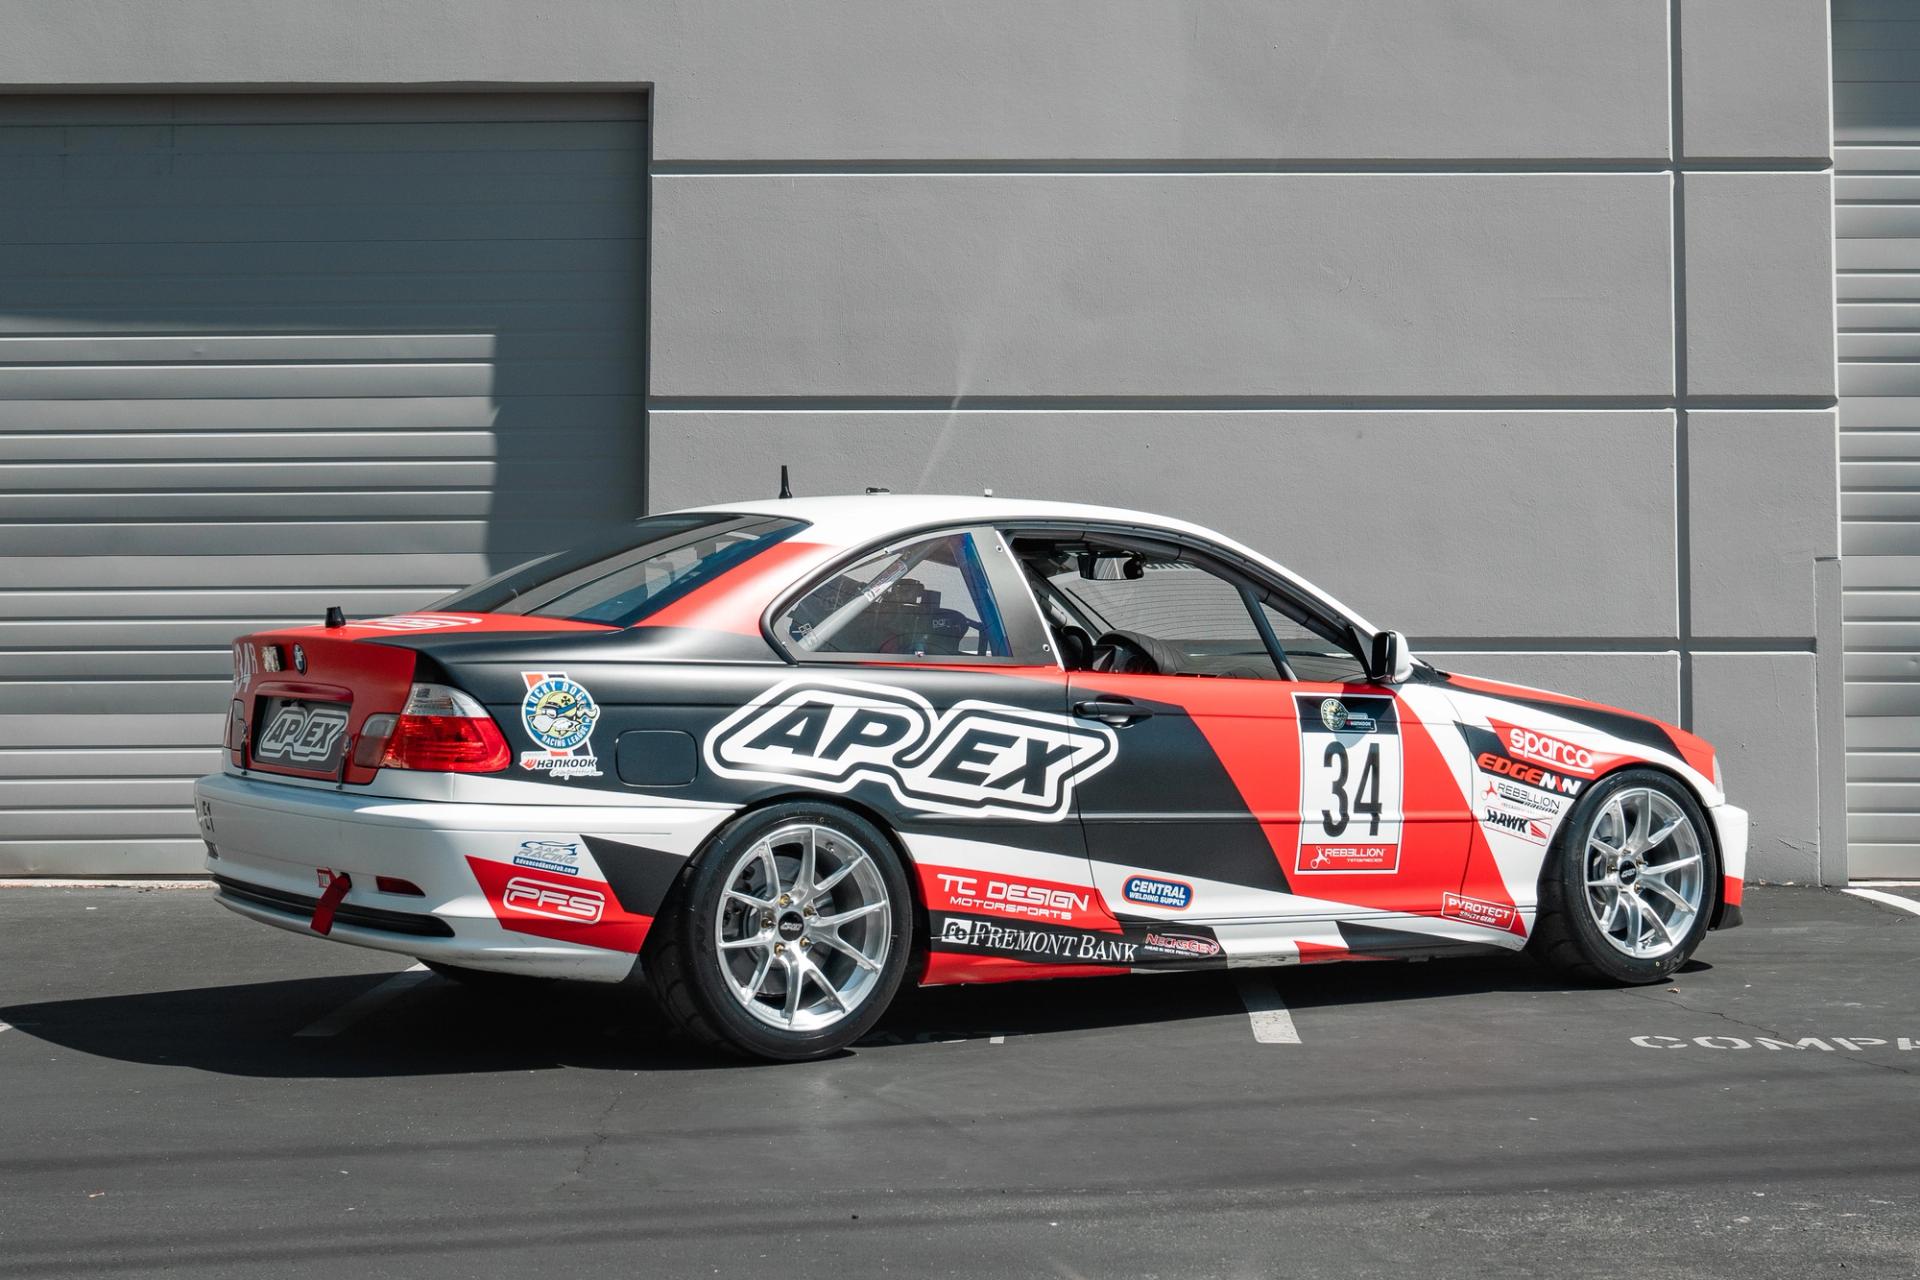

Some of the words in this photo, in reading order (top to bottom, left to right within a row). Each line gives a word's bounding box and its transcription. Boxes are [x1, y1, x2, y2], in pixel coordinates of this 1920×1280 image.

[526, 681, 557, 712] LUCKY
[743, 701, 1081, 797] APEX
[1510, 728, 1593, 769] sparco
[1322, 741, 1382, 837] 34
[1487, 809, 1529, 833] HAWK
[507, 883, 600, 918] PFS
[937, 874, 977, 896] TC
[986, 881, 1089, 912] DESIGN
[1130, 891, 1159, 903] WELDING
[1159, 896, 1186, 907] SUPPLY
[1131, 880, 1186, 899] CENTRAL
[950, 896, 1072, 921] MOTORSPORTS
[1448, 898, 1511, 919] PYROTECT
[970, 920, 1078, 957] FREMONT
[1077, 934, 1139, 963] BANK
